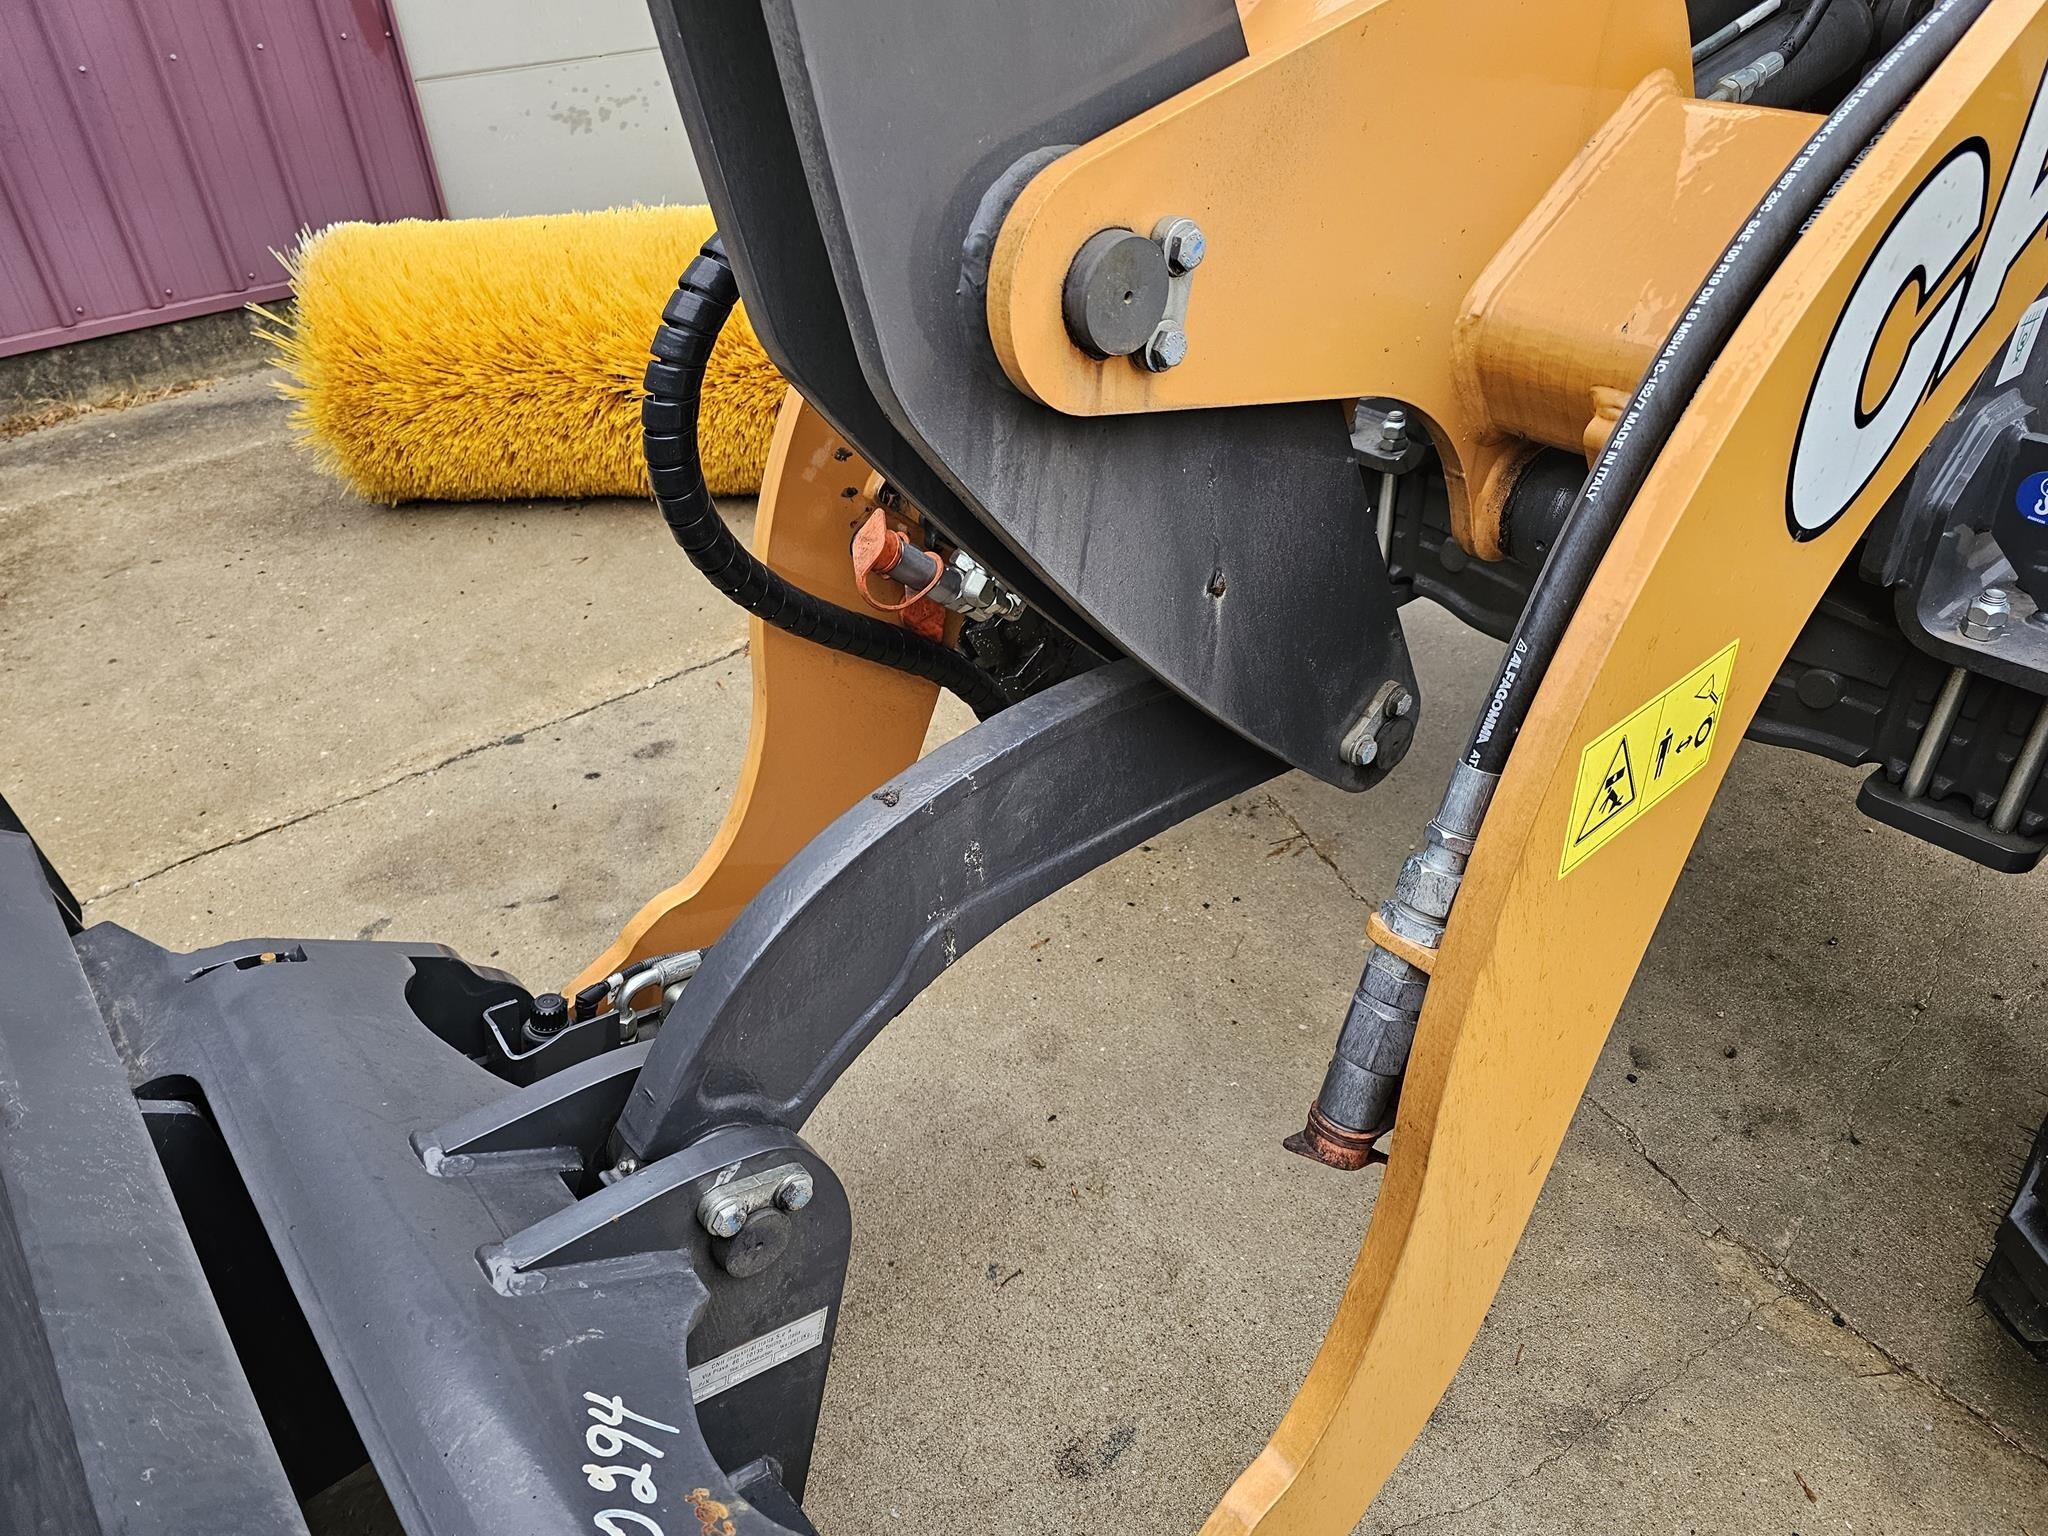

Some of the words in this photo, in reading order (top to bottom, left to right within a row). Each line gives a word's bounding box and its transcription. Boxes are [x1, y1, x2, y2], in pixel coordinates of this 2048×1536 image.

[1803, 141, 1821, 157] ST
[1790, 156, 1810, 173] EN
[1777, 171, 1797, 192] 857
[1737, 218, 1761, 245] SAE
[1724, 244, 1743, 265] 100
[1708, 262, 1729, 287] R19
[1694, 285, 1715, 306] DN
[1685, 305, 1701, 322] 16
[1662, 319, 1693, 359] MSHA
[1634, 359, 1669, 411] IC-152/7
[1610, 411, 1639, 451] MADE
[1602, 450, 1617, 466] IN
[1586, 466, 1609, 502] ITALY
[1476, 651, 1522, 744] ALFAGOMMA
[728, 1344, 757, 1360] Industrial
